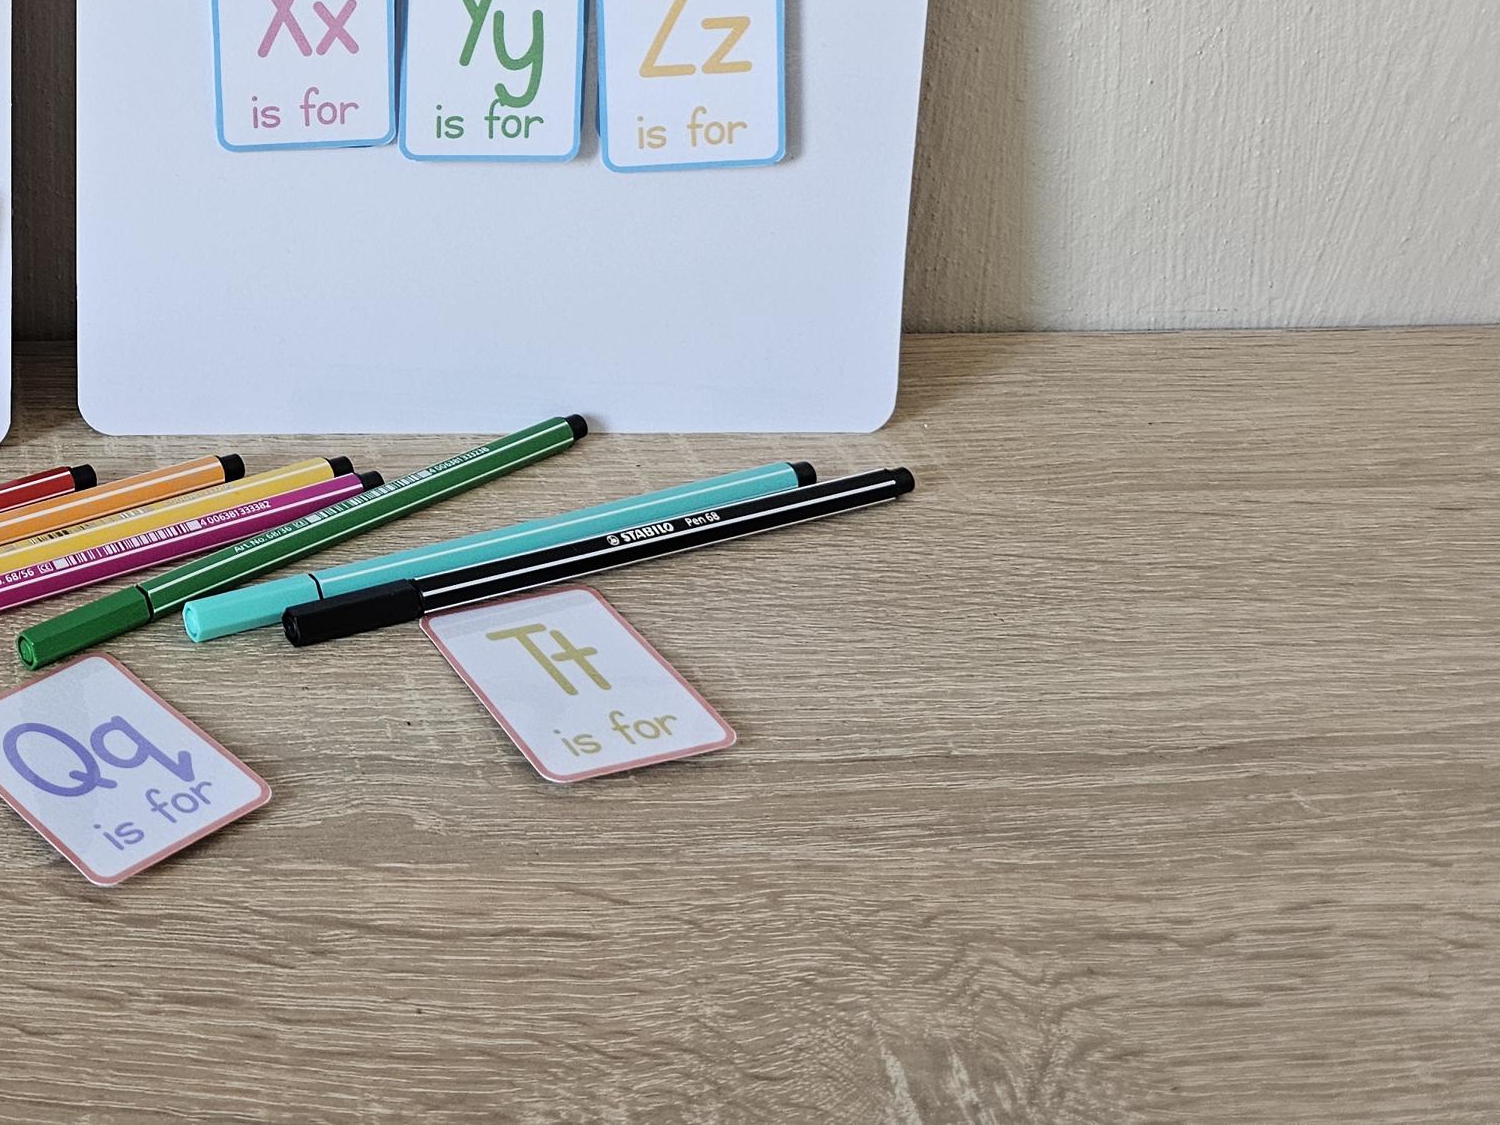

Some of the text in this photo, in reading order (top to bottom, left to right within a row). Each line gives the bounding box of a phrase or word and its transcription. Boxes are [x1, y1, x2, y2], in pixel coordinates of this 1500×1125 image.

[252, 87, 359, 128] is for
[436, 96, 544, 139] is for
[637, 106, 747, 149] is for
[250, 535, 268, 546] No.
[620, 511, 721, 543] STABILO Pen 68
[5, 568, 35, 583] 68/56
[487, 624, 613, 696] Tt
[553, 710, 678, 757] is for
[2, 715, 193, 797] Qq
[93, 779, 214, 850] is for
